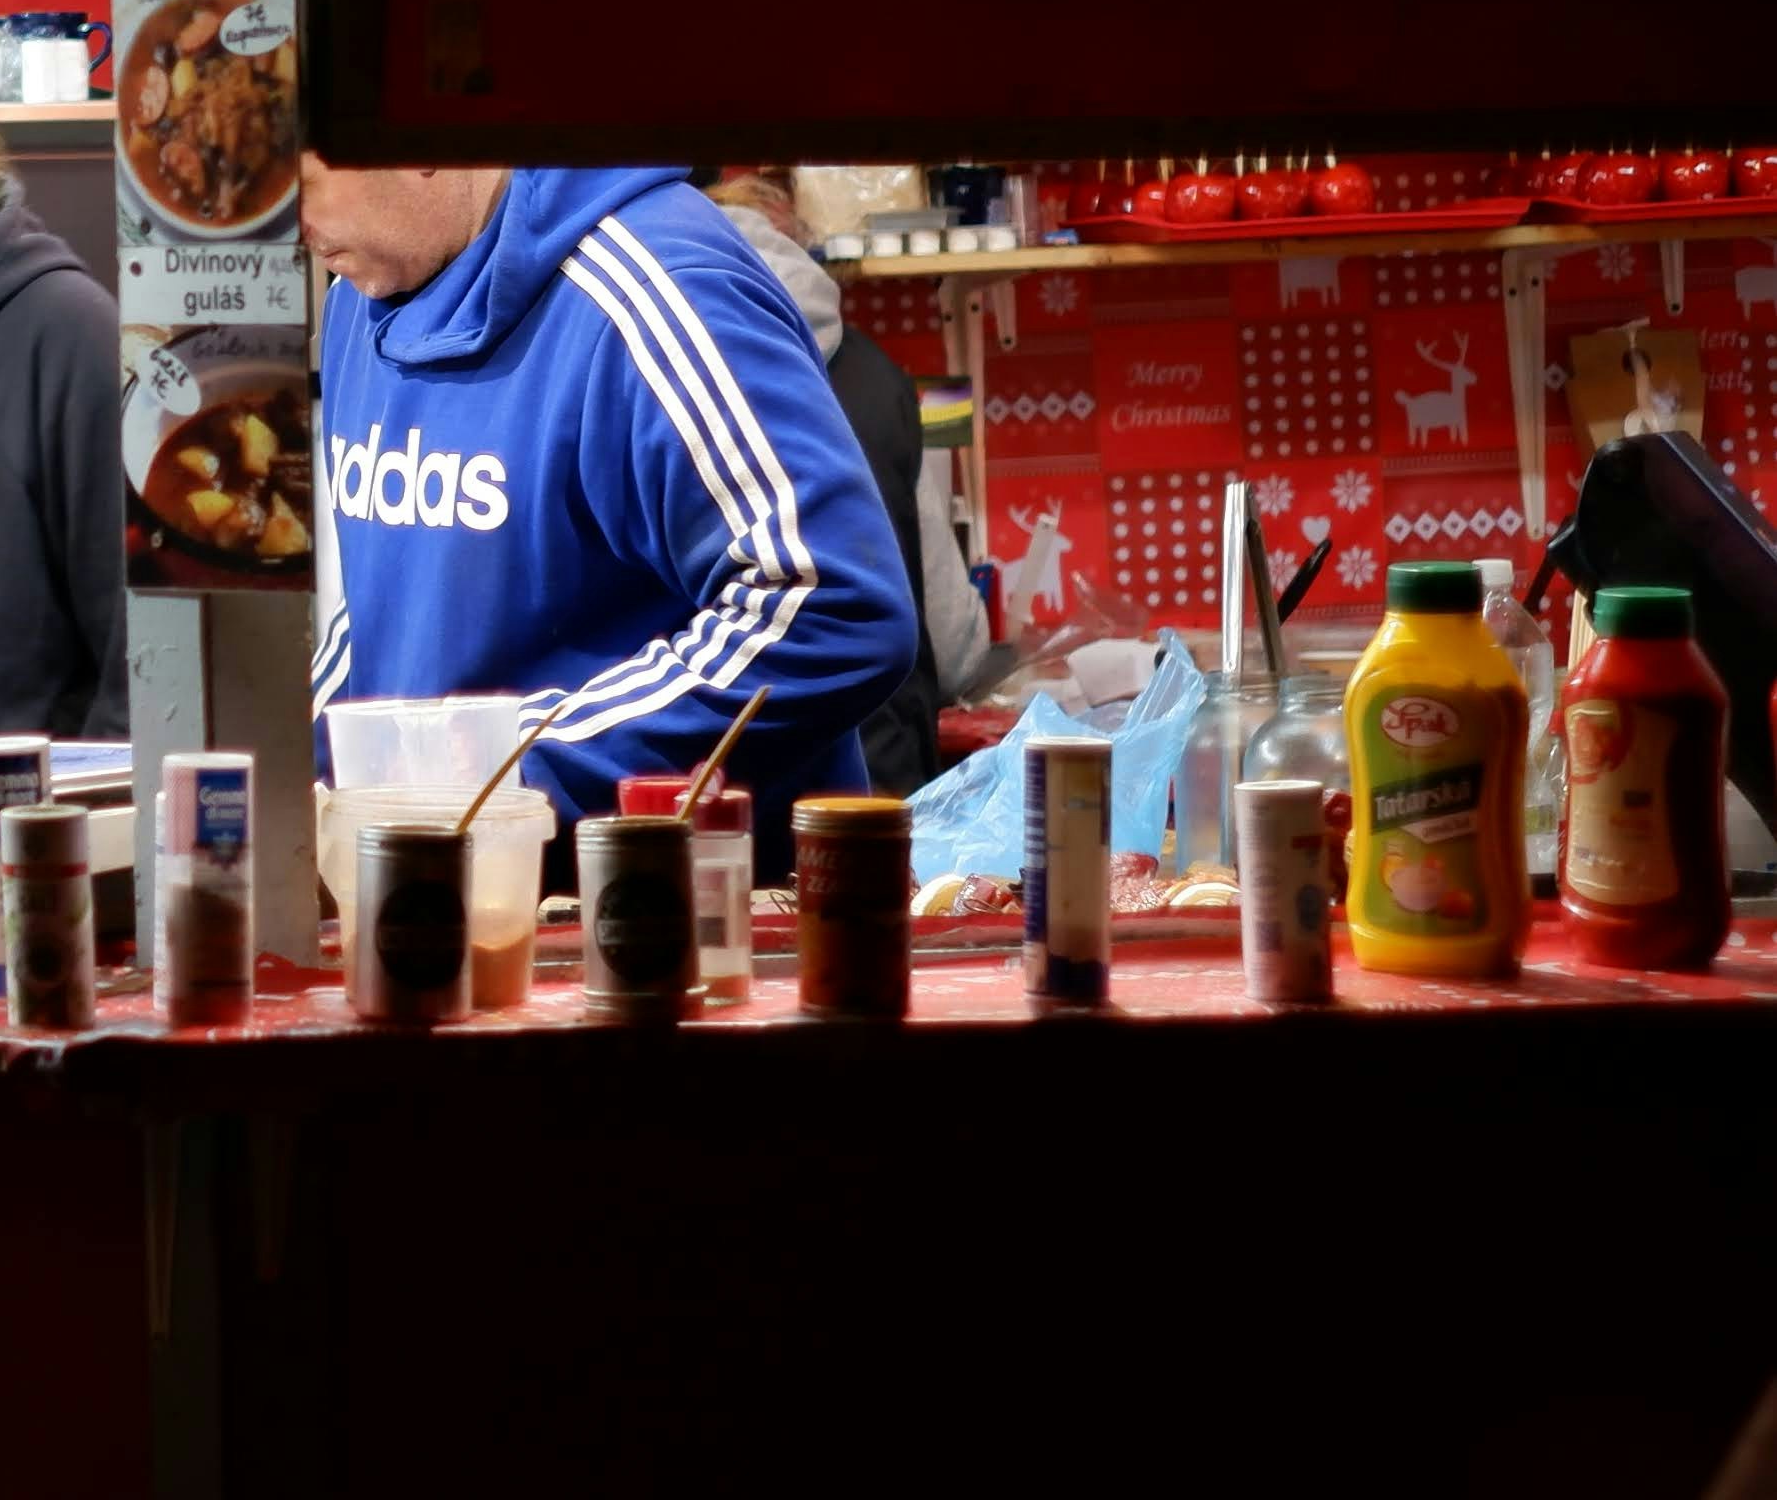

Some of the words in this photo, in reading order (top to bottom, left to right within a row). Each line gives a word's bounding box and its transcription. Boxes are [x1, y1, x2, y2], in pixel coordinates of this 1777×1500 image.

[165, 247, 264, 279] Divinový
[183, 284, 246, 317] guláš
[1126, 359, 1204, 395] Merry
[1110, 399, 1233, 434] Christmas
